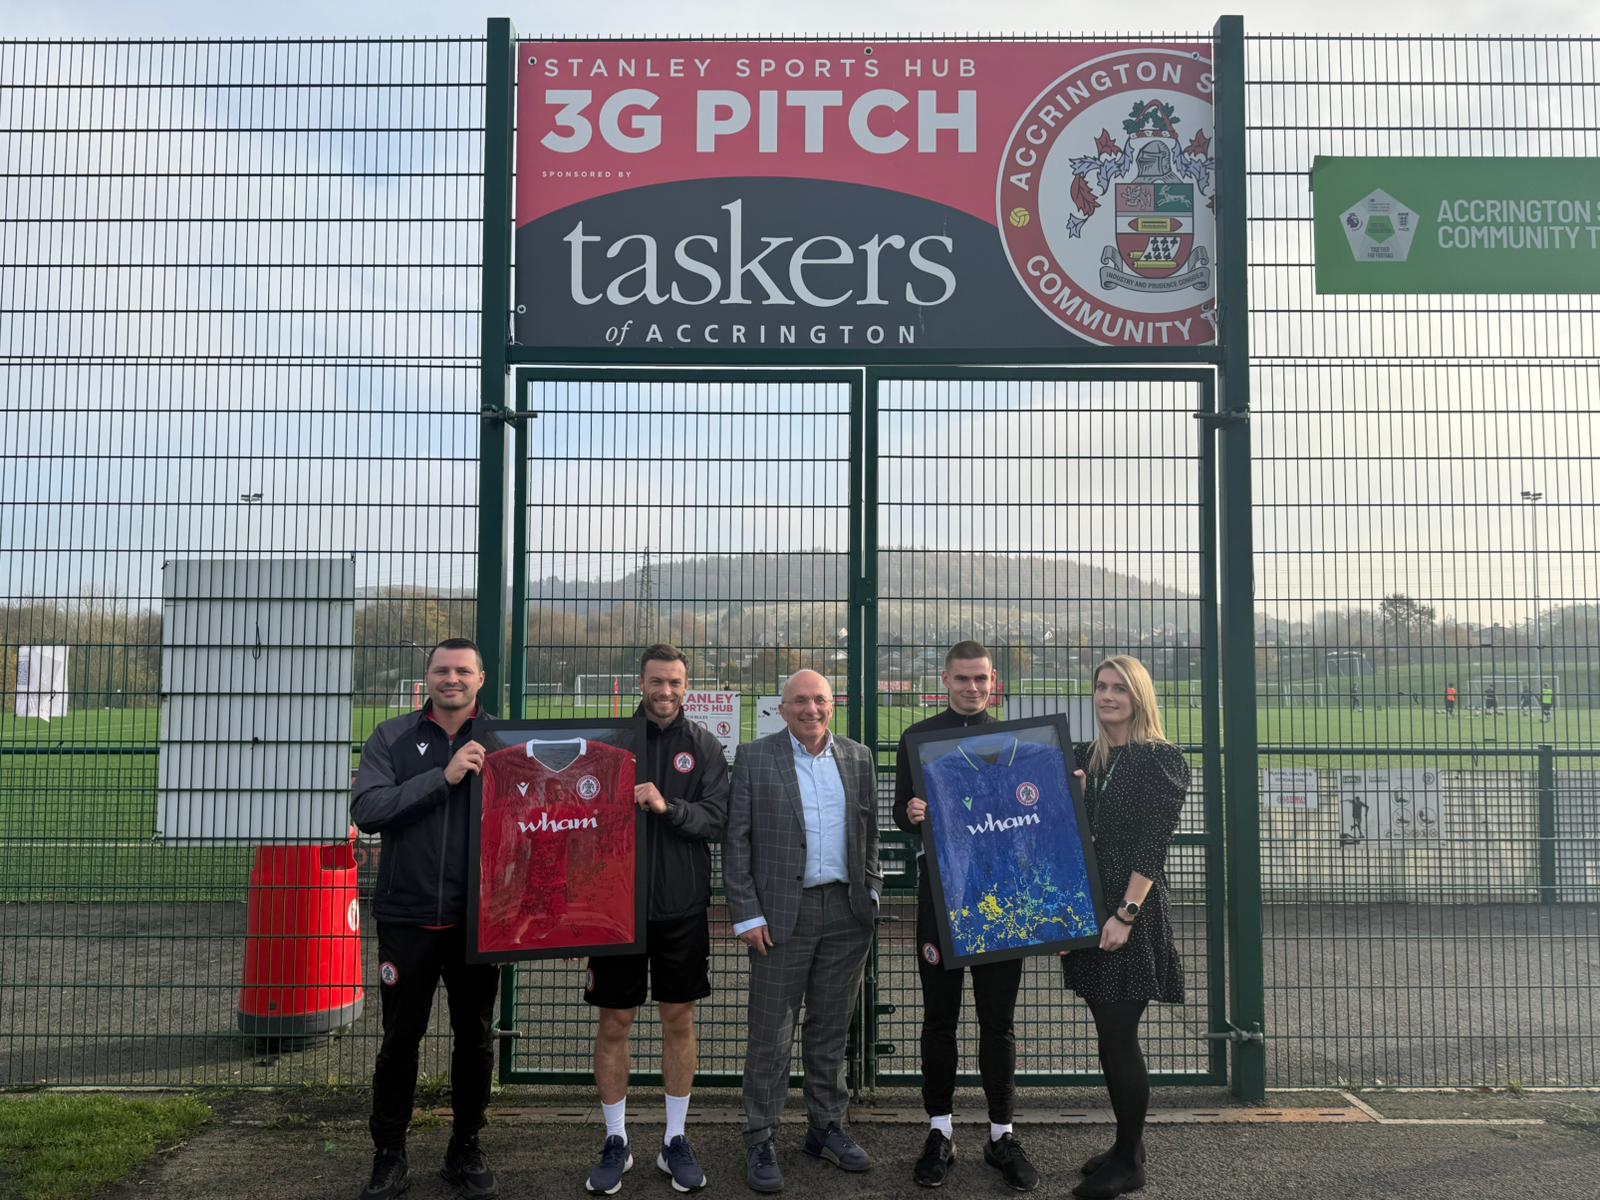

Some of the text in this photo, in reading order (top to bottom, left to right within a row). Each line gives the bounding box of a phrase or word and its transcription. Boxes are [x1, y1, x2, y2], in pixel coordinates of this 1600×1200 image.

[544, 58, 977, 78] STANLEY SPORTS HUB
[540, 88, 977, 154] 3G PITCH
[1009, 61, 1183, 192] ACCRINGTON
[542, 170, 632, 178] SPONSORED BY
[1437, 199, 1592, 223] ACCRINGTON
[1438, 225, 1581, 249] COMMUNITY
[562, 198, 957, 307] taskers
[1135, 279, 1147, 288] AND
[1026, 255, 1193, 344] COMMUNITY
[605, 320, 916, 346] of ACCRINGTON
[712, 704, 734, 712] HUB
[517, 812, 599, 833] wham
[965, 812, 1041, 836] wham
